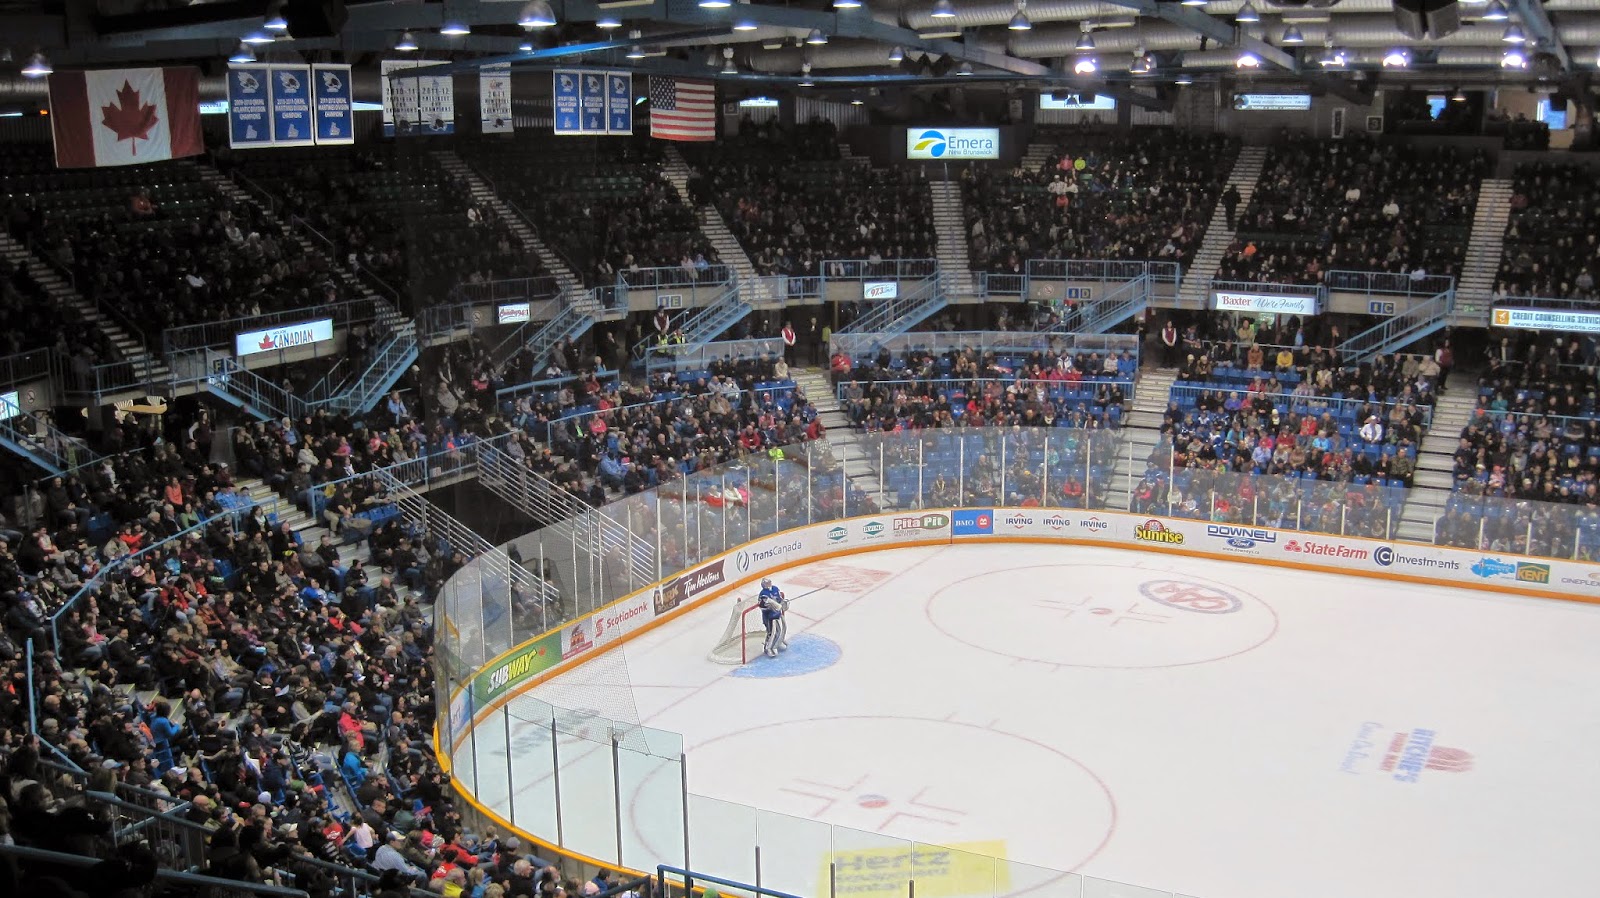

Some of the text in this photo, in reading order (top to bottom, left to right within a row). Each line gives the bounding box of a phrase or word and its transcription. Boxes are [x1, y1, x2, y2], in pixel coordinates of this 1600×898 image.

[948, 136, 992, 149] Emera
[1222, 295, 1252, 306] Baxter
[1512, 312, 1533, 321] CREDIT
[1535, 313, 1576, 323] COUNSELLING
[273, 329, 314, 348] CANADIAN
[863, 525, 885, 533] IRVING
[894, 517, 943, 530] Pita Pit
[955, 519, 974, 527] BMO
[1043, 519, 1071, 527] IRVING
[1080, 520, 1108, 529] IRVING
[827, 530, 848, 538] IRVING
[1135, 524, 1184, 545] Sunrise
[1208, 525, 1276, 543] DOWNEY
[752, 541, 802, 563] TransCanada
[1396, 553, 1459, 570] Investments
[1518, 569, 1547, 582] KENT
[684, 572, 720, 598] Tim Hortons
[606, 601, 648, 629] Scotiabank
[487, 649, 537, 695] SUBWAY
